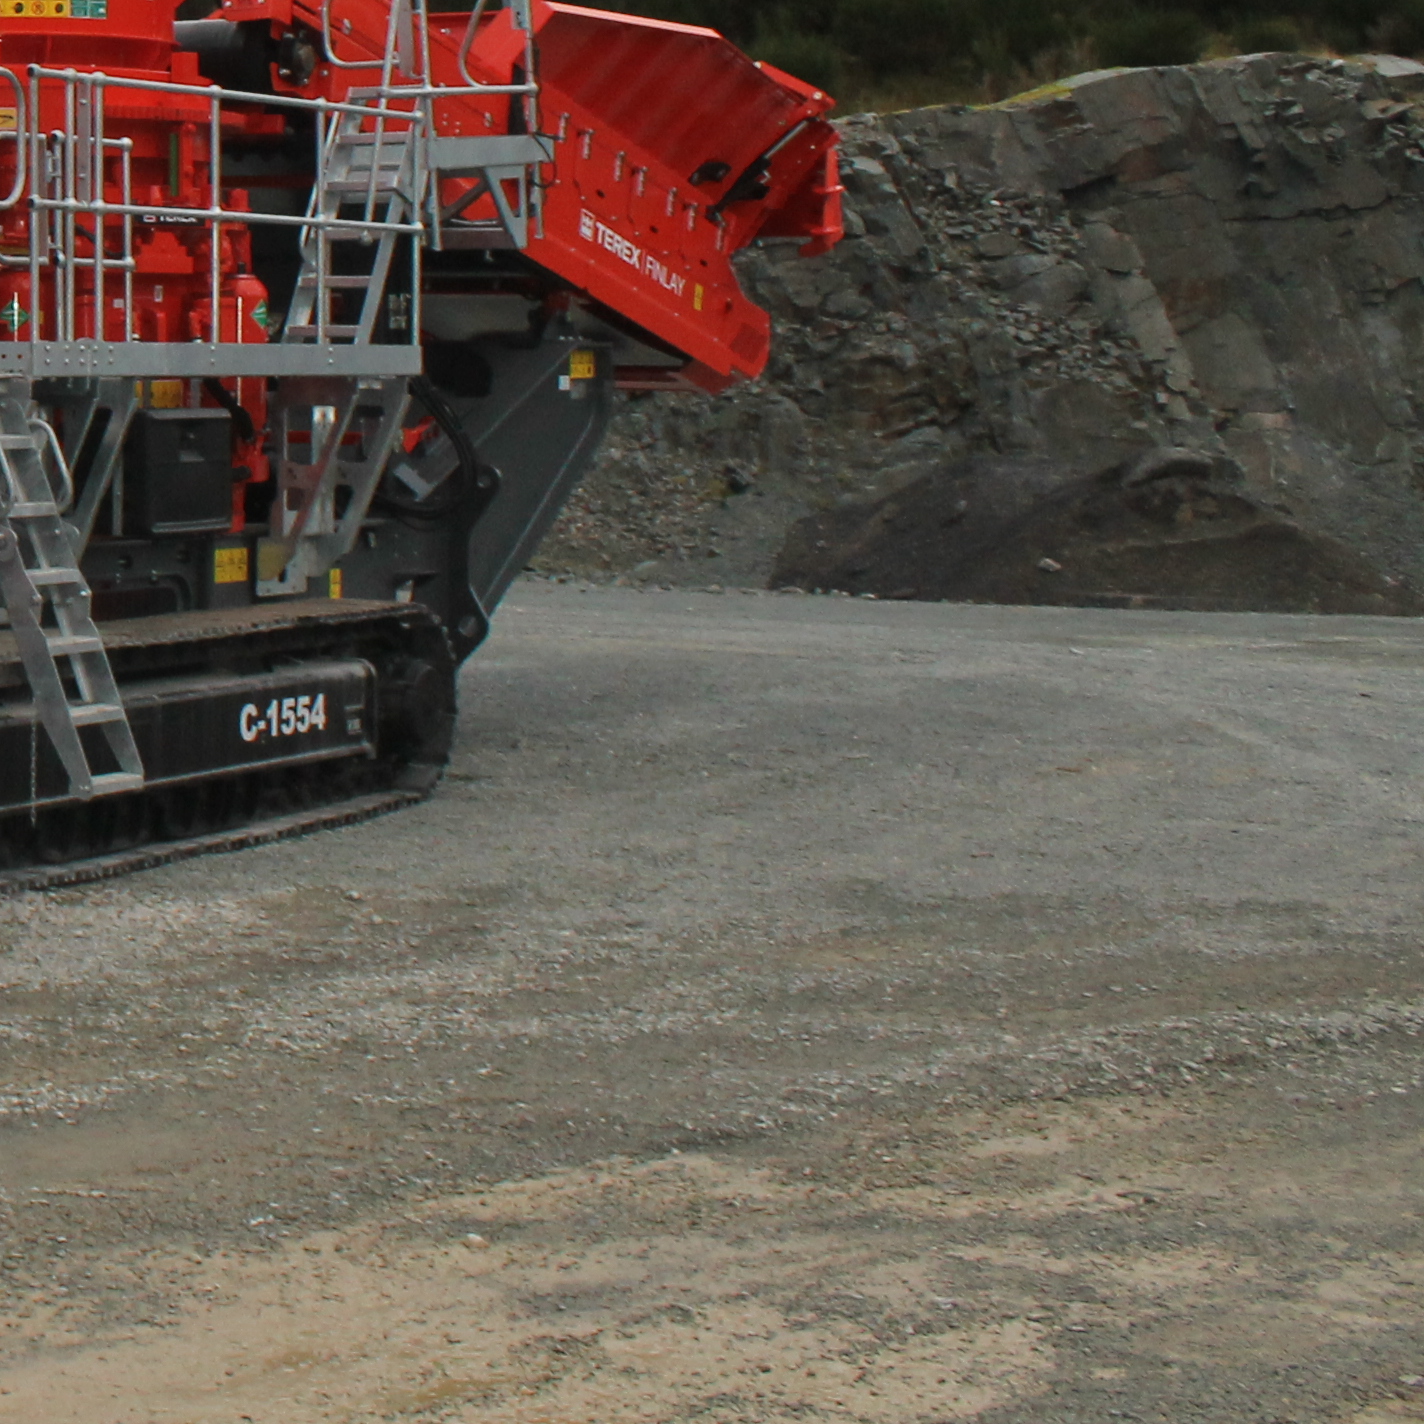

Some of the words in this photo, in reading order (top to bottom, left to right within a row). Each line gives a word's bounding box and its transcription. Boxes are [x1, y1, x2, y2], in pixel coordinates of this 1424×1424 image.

[595, 220, 642, 270] TEREX
[645, 254, 687, 297] FINLAY
[239, 693, 326, 742] C-1554
